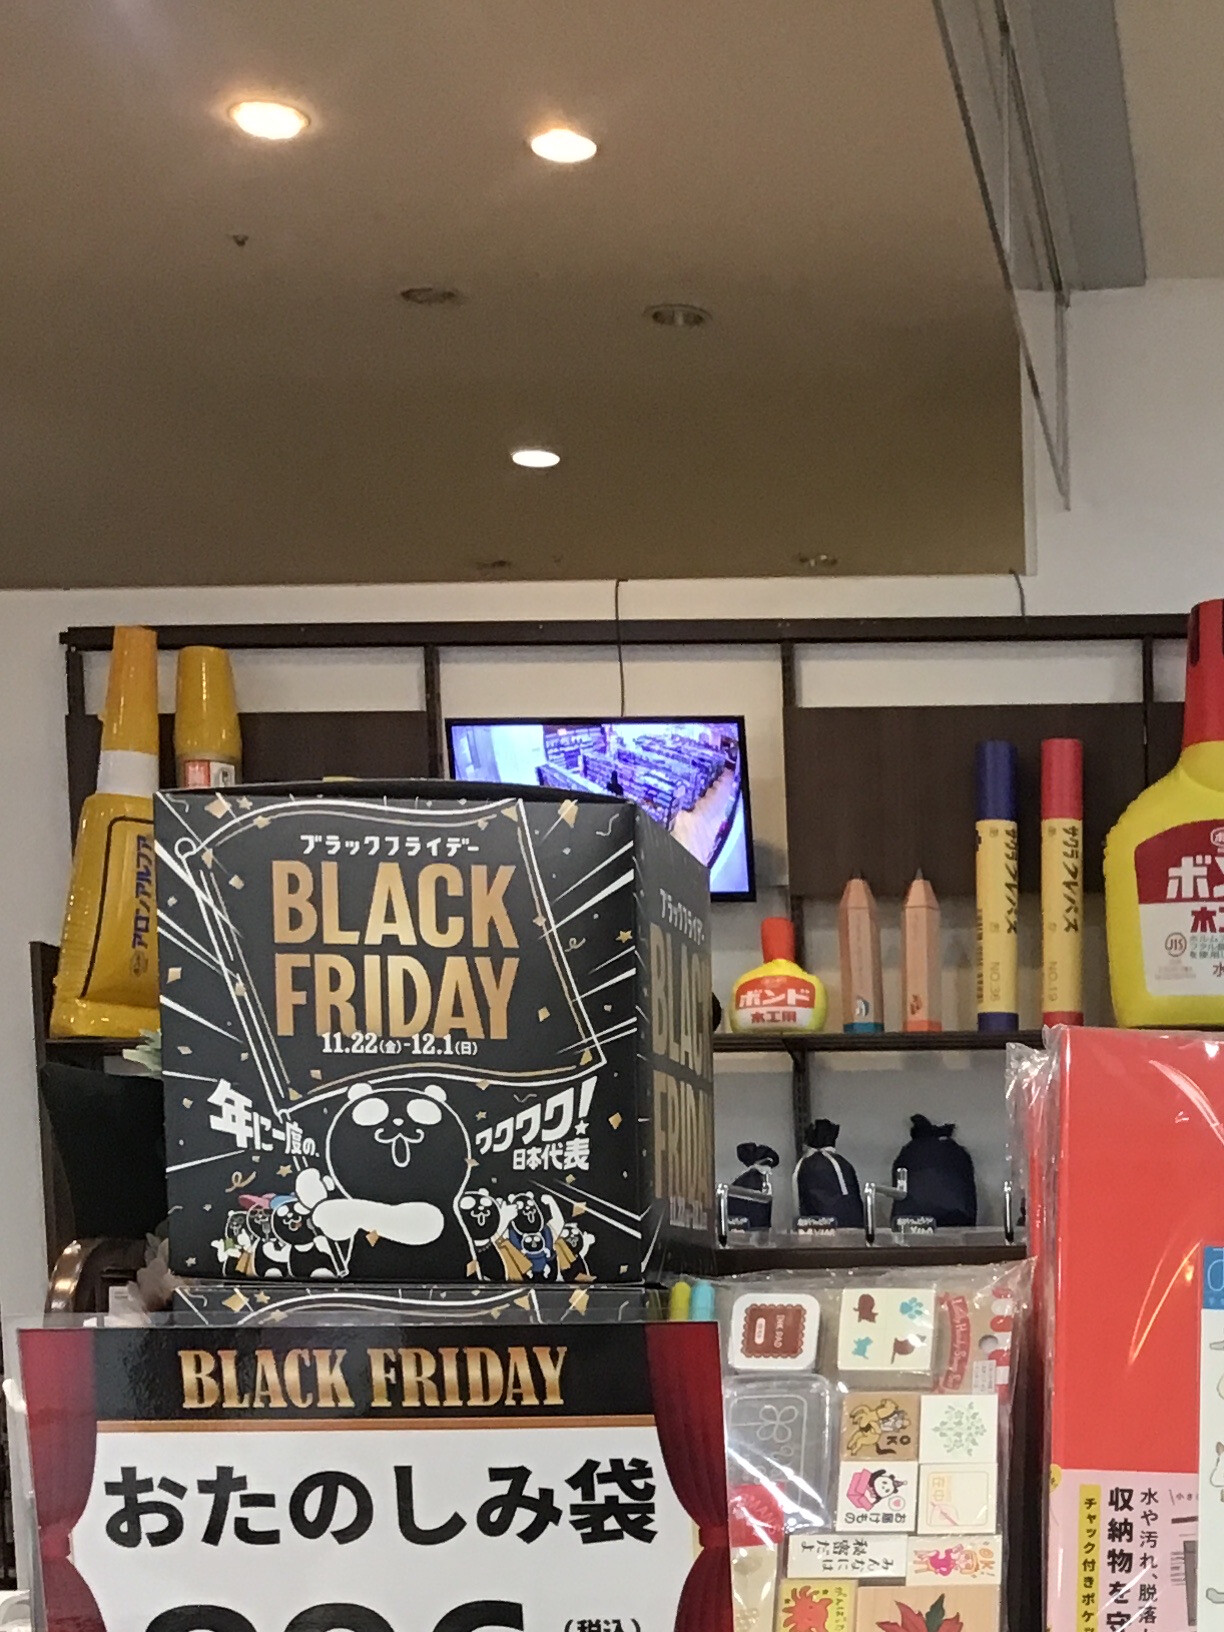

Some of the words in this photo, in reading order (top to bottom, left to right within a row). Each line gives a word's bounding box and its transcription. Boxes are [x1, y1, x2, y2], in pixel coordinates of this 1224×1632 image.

[300, 834, 479, 857] ブラックフライデー
[1062, 825, 1079, 933] サクラクレパス
[272, 860, 519, 948] BLACK
[275, 953, 519, 1039] FRIDAY
[739, 988, 811, 1008] ボンド
[751, 1010, 797, 1024] 木工用
[512, 1137, 590, 1171] 日本代表
[179, 1348, 356, 1410] BLACK
[367, 1345, 569, 1407] FRIDAY
[104, 1458, 659, 1548] おたのしみ袋
[800, 1539, 869, 1557] 秘密だよ
[821, 1556, 895, 1573] みんなには
